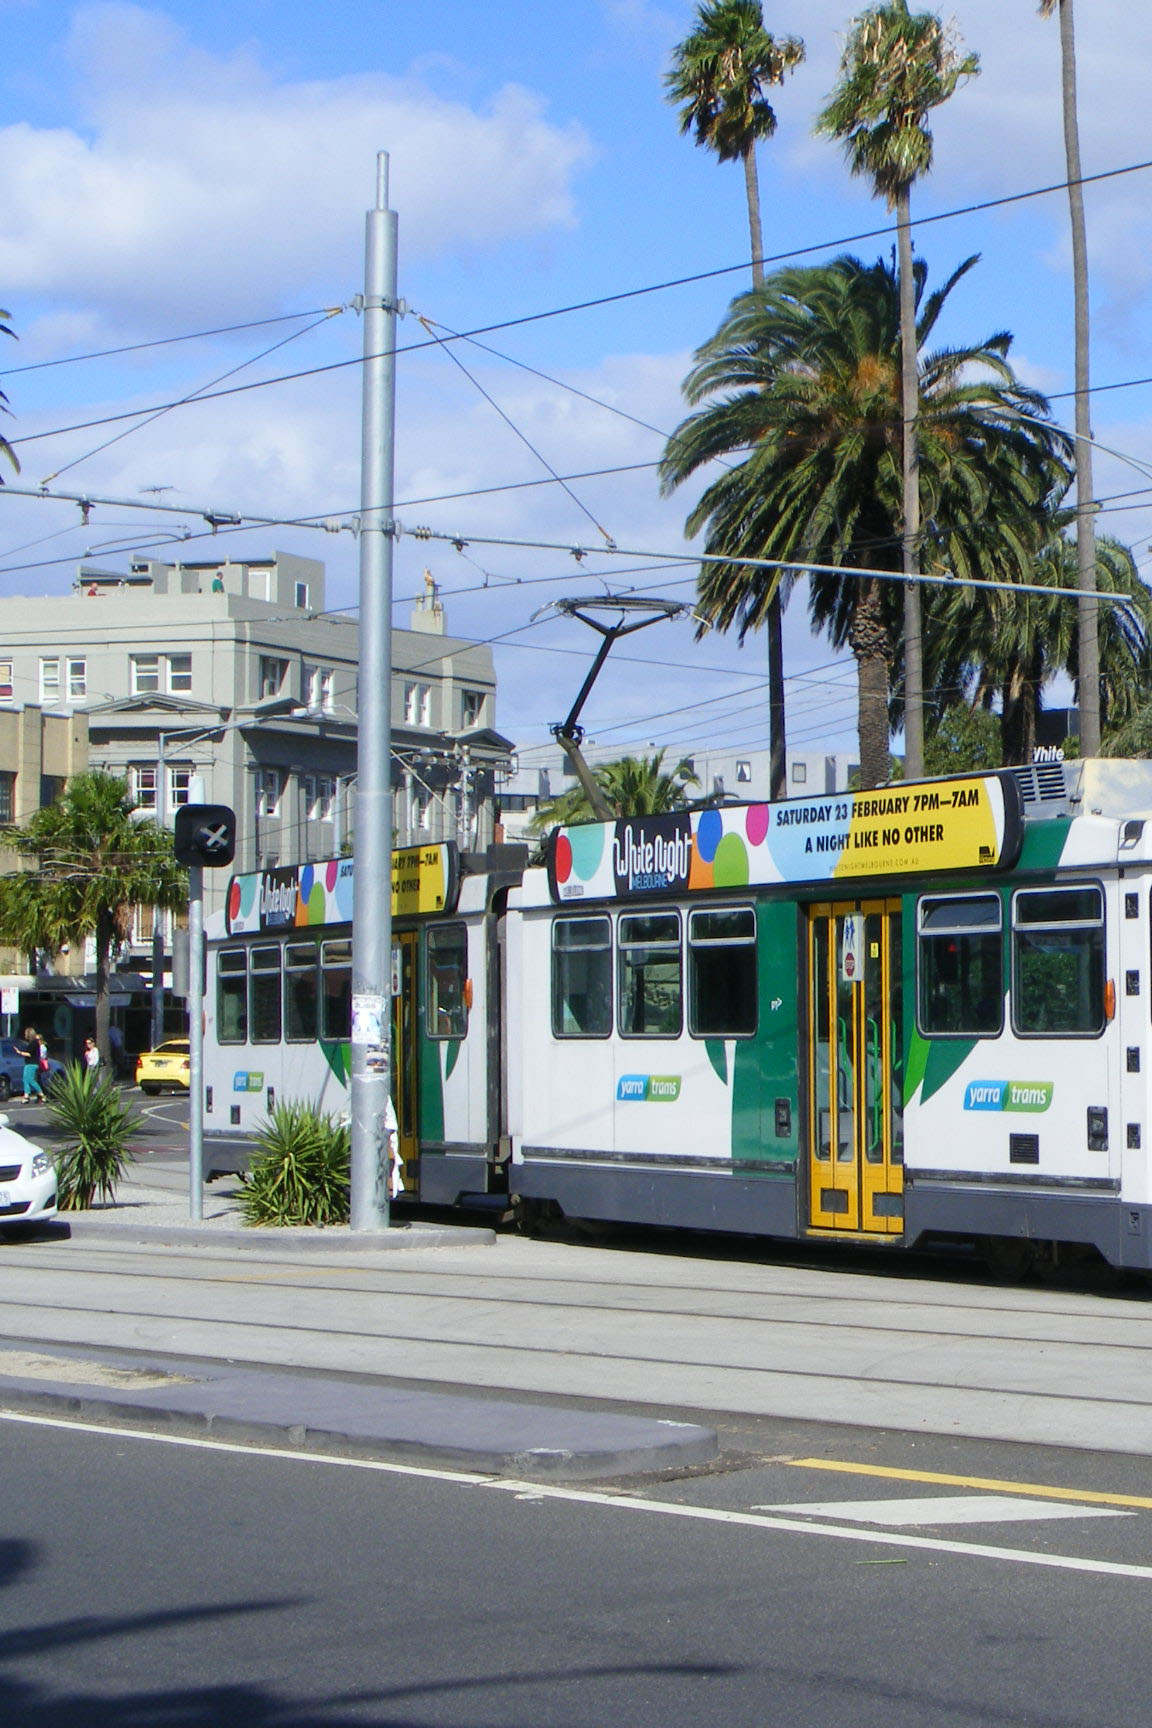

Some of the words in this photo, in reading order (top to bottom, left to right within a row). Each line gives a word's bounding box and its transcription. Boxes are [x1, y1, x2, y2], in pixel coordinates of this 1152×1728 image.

[776, 804, 832, 826] SATURDAY
[835, 803, 848, 821] 23
[851, 796, 911, 819] FEBRUARY
[805, 837, 813, 853] A
[816, 834, 850, 852] NIGHT
[854, 830, 878, 849] LIKE
[882, 828, 900, 846] NO
[904, 824, 944, 844] OTHER
[632, 873, 668, 889] MELBOURNE
[620, 1080, 644, 1098] yarra
[651, 1077, 677, 1096] trams
[969, 1087, 1000, 1107] yarra
[1011, 1085, 1046, 1105] trams
